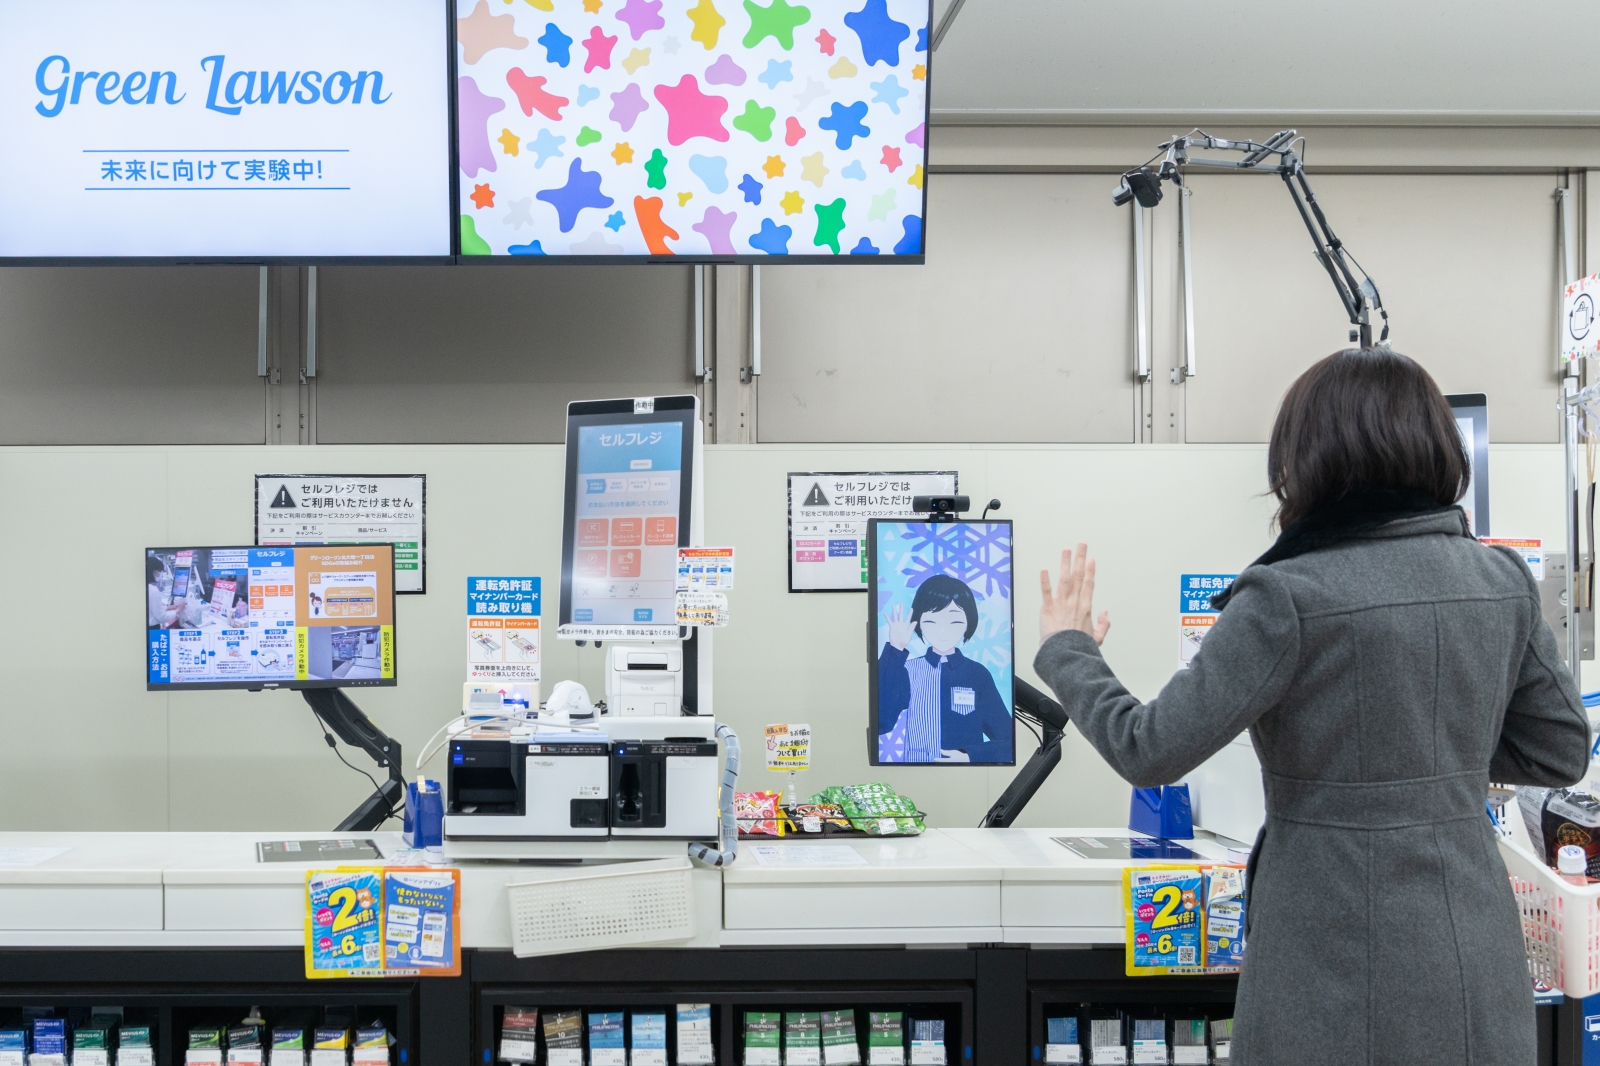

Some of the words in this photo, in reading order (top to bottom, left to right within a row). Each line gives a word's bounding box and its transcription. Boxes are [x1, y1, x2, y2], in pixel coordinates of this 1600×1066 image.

[35, 55, 186, 118] Green
[200, 55, 392, 115] Lawson
[101, 160, 322, 183] 未来に向けて実験中!
[635, 401, 654, 409] 作動中
[599, 431, 662, 447] セルフレジ
[301, 483, 378, 494] セルフレジでは
[834, 481, 911, 492] セルフレジでは
[301, 497, 414, 509] ご利用いただけません
[476, 579, 532, 591] 運転免許証
[469, 593, 538, 601] マイナンバーカード
[476, 602, 532, 613] 読み取り機
